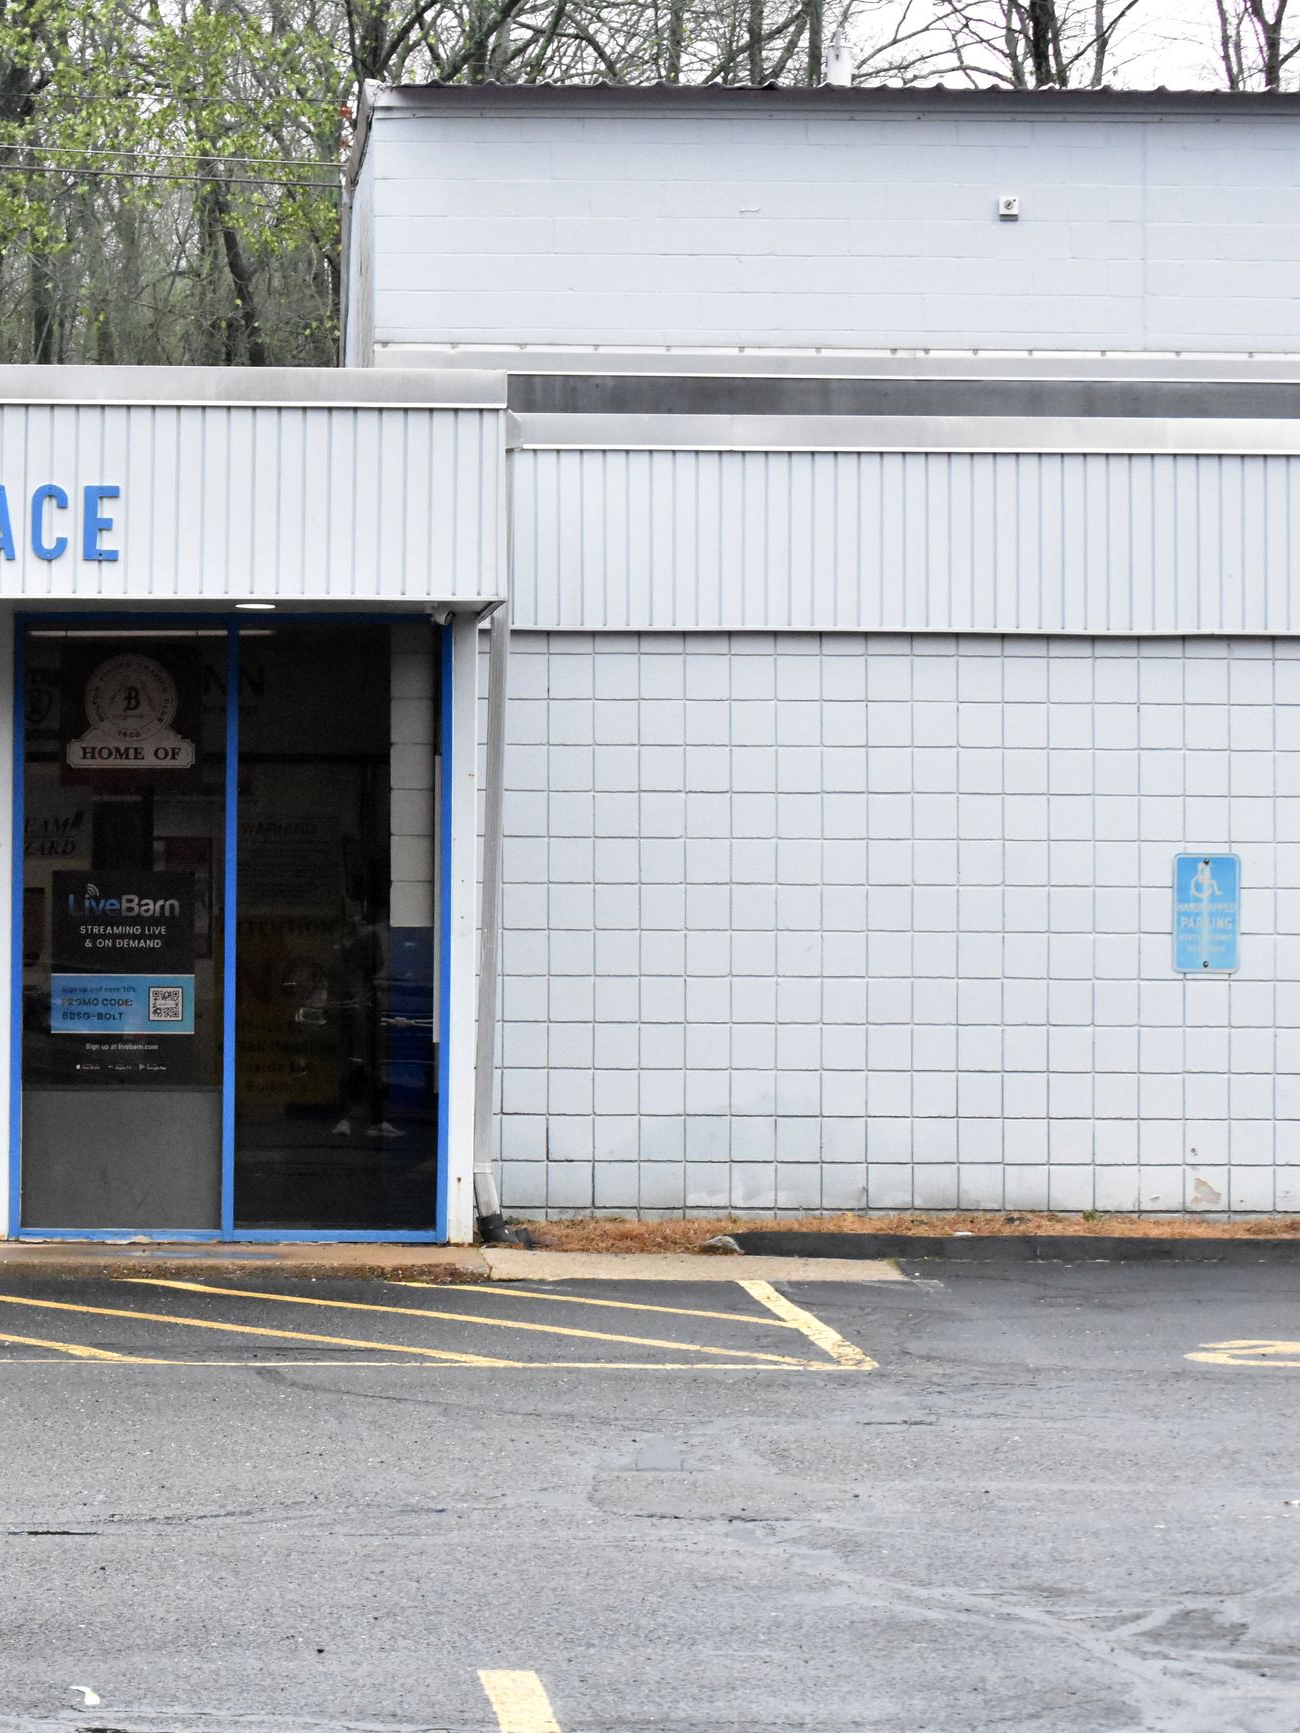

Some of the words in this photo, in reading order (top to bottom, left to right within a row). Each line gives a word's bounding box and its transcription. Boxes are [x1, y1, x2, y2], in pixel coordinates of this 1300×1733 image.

[81, 746, 144, 760] HOME
[153, 746, 182, 760] OF
[68, 893, 180, 917] LiveBarn
[80, 926, 142, 934] STREAMING
[145, 926, 167, 934] LIVE
[85, 939, 93, 947] &
[96, 939, 112, 947] ON
[116, 939, 162, 947] DEMAND
[61, 998, 99, 1006] PROMO
[101, 998, 133, 1006] CODE:
